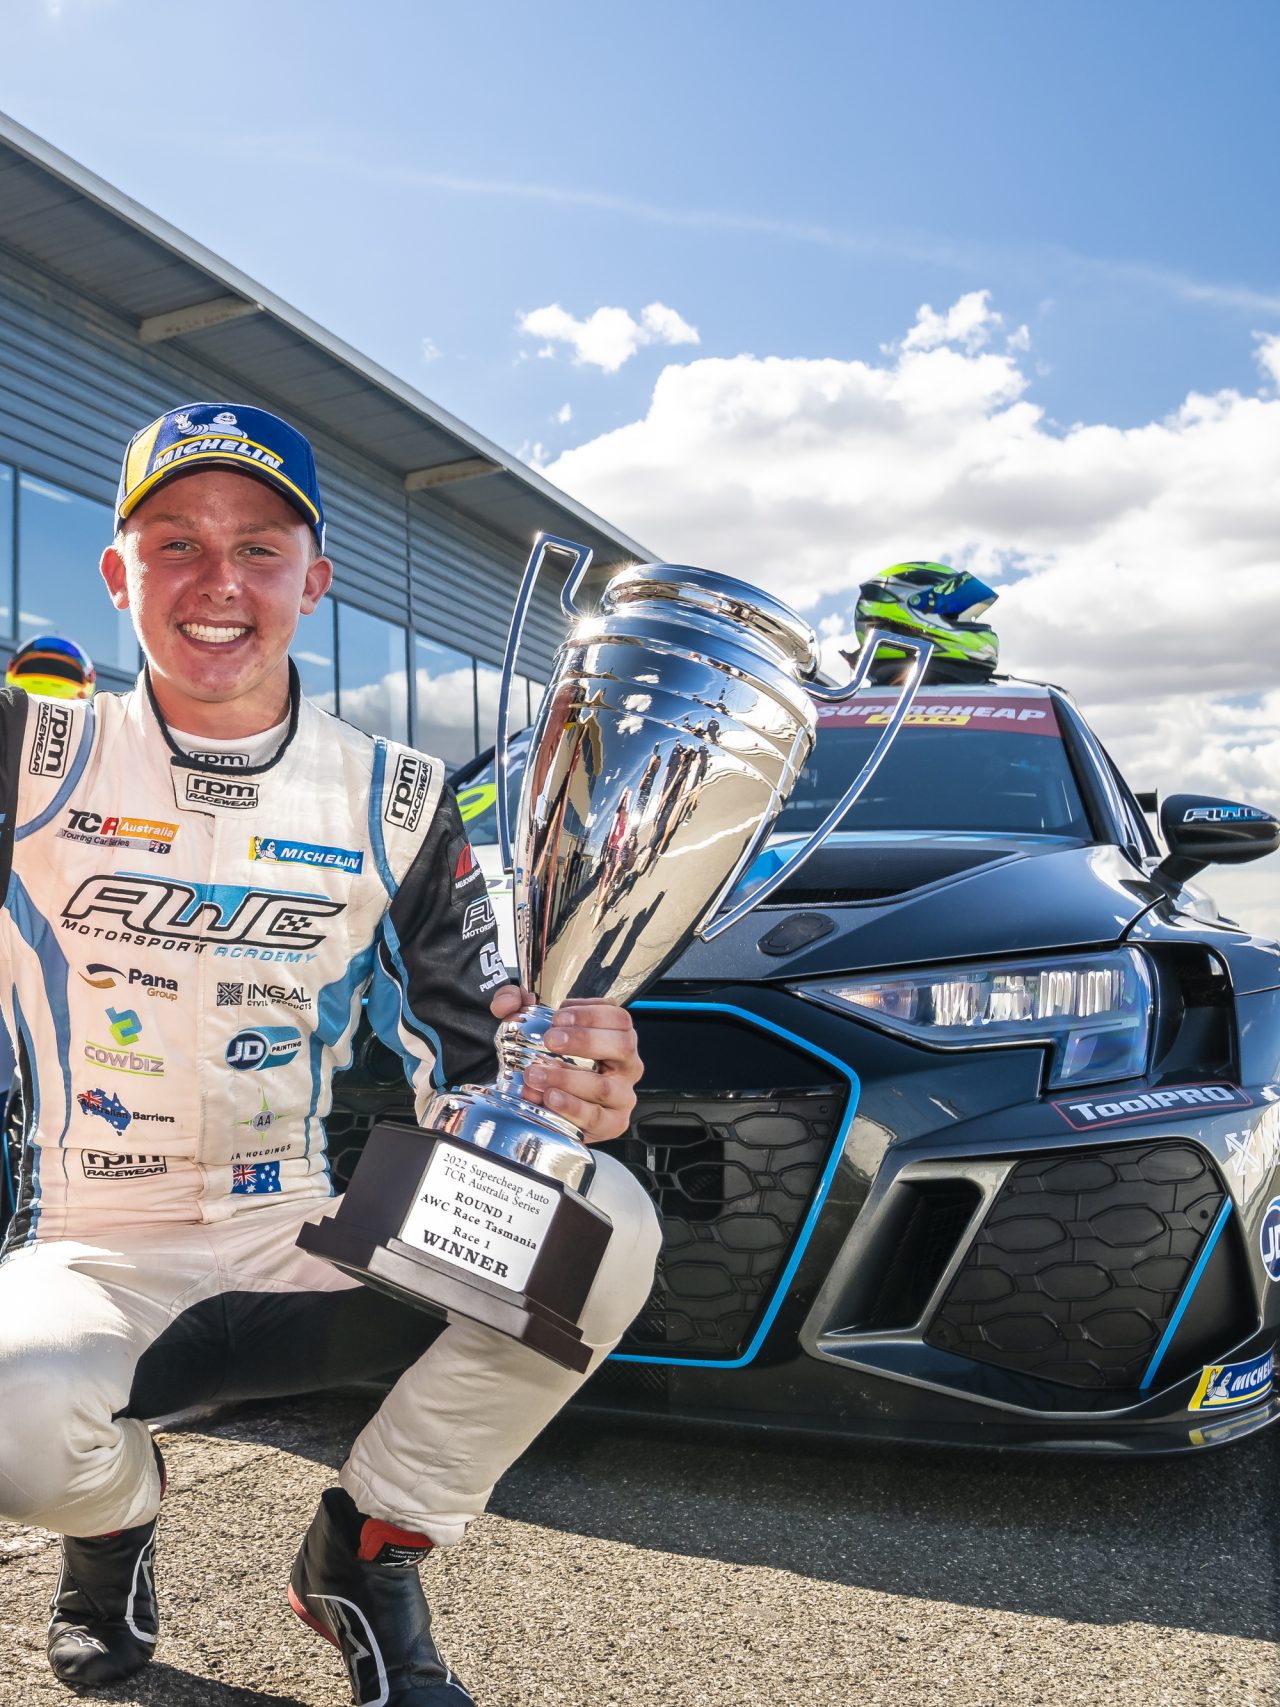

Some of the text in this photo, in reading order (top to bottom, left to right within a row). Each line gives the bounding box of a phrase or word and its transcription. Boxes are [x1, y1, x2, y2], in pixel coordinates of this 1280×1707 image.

[153, 438, 281, 472] MICHELIN
[32, 704, 50, 773] RACEWEAR
[45, 708, 69, 772] rpm
[193, 753, 244, 766] rpm
[188, 792, 256, 807] RACEWEAR
[193, 778, 255, 797] rpm
[391, 758, 417, 820] rpm
[408, 762, 429, 829] RACEWEAR
[62, 829, 93, 844] Touring
[93, 836, 108, 846] Car
[121, 822, 175, 838] Australia
[280, 847, 360, 869] MICHELIN
[60, 873, 348, 950] AWC
[60, 918, 319, 964] MOTORSPORT ACADEMY
[128, 968, 179, 991] Pana
[147, 987, 178, 1002] Group
[247, 983, 312, 1003] INGAL
[271, 998, 312, 1011] PRODUCTS
[84, 1045, 165, 1073] cowbiz
[227, 1040, 302, 1062] JD PRINTING
[1070, 1086, 1235, 1121] ToolPRO
[132, 1111, 176, 1123] Barriers
[257, 1114, 271, 1127] AA
[246, 1143, 292, 1158] HOLDINGS
[86, 1166, 165, 1177] RACEWEAR
[443, 1152, 550, 1205] 2022 Supercheap Auto
[444, 1165, 541, 1215] TCR Australia Series
[454, 1191, 513, 1224] ROUND 1
[420, 1193, 538, 1250] AWC Race Tasmania
[452, 1225, 491, 1250] Race 1
[422, 1229, 510, 1278] WINNER
